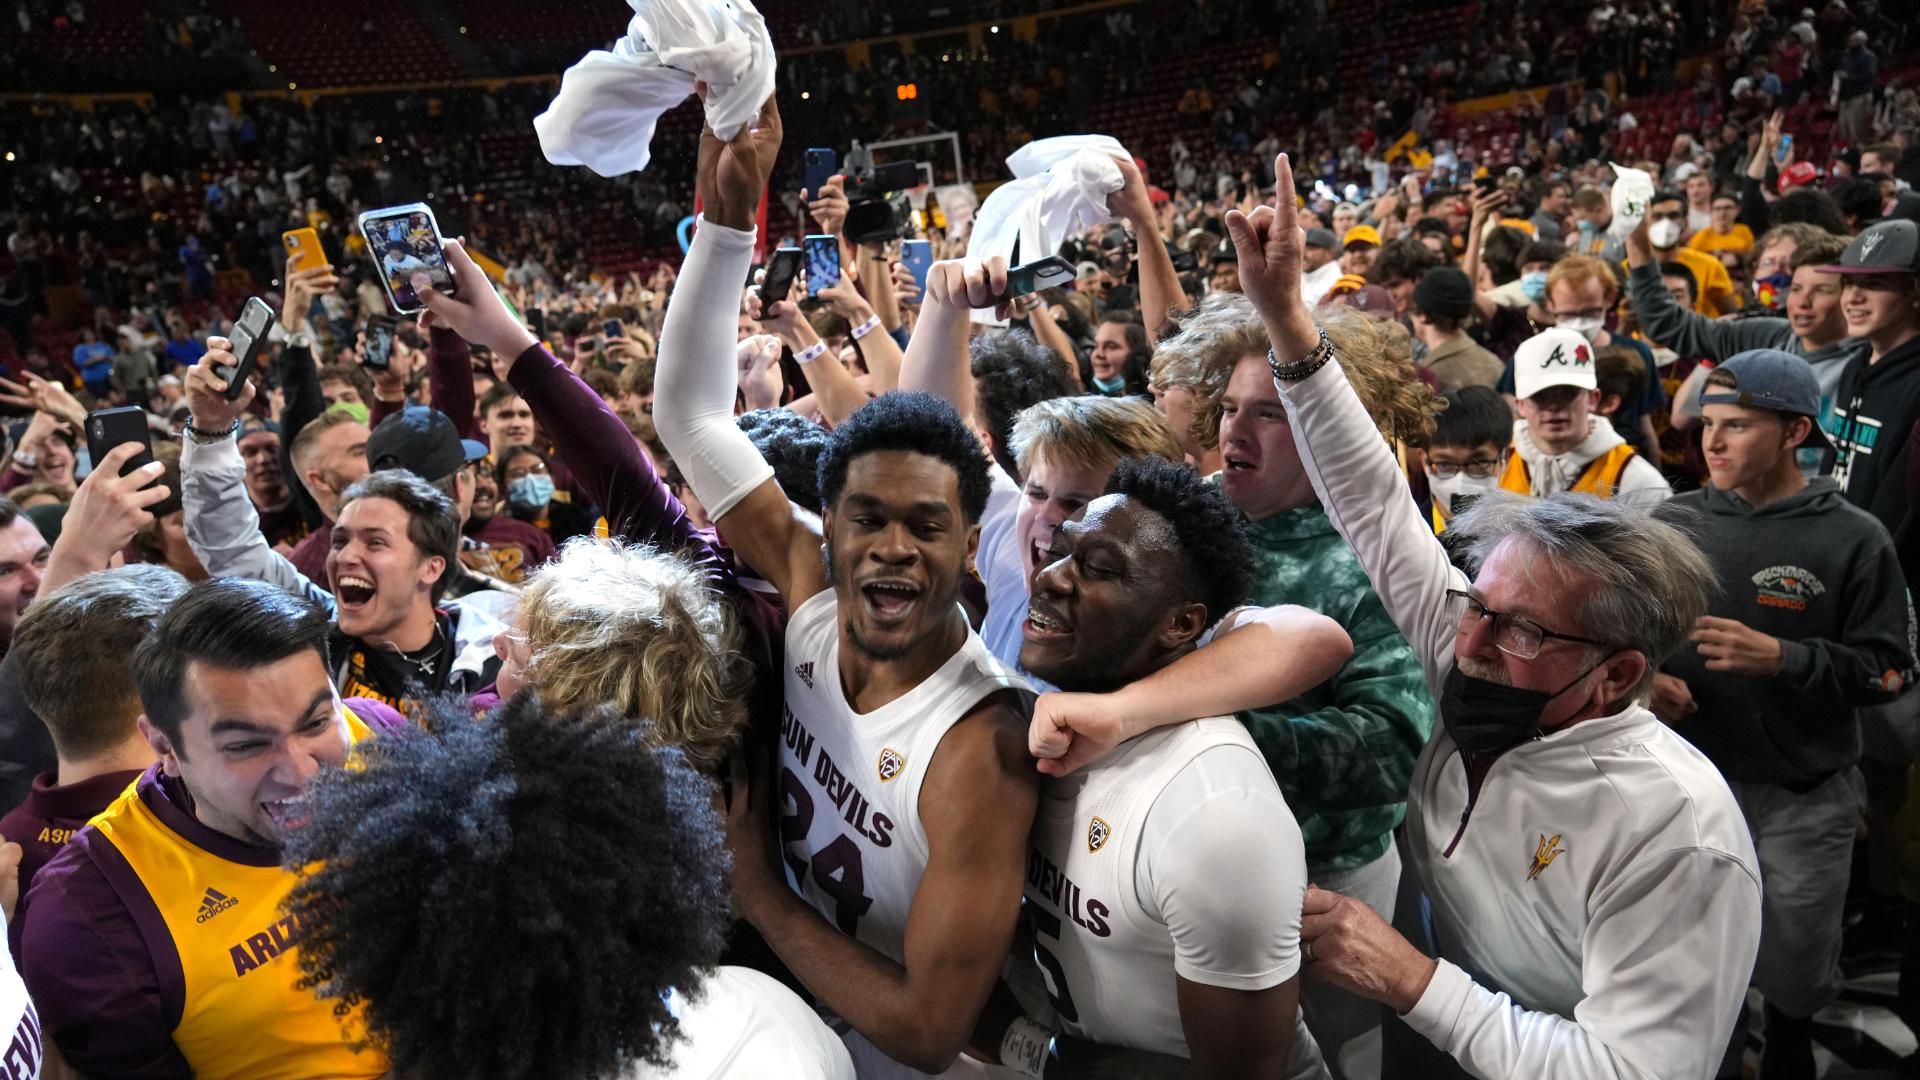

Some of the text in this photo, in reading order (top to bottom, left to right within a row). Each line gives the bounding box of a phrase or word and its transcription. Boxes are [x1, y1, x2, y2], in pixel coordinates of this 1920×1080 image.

[1540, 343, 1568, 369] A
[794, 665, 814, 690] adidas
[781, 701, 895, 848] SUN DEVILS
[880, 750, 904, 775] PAC
[880, 763, 895, 778] 12
[1090, 819, 1108, 842] PAC
[1090, 833, 1100, 849] 12
[779, 766, 874, 940] 24
[1029, 847, 1112, 938] DEVILS
[196, 896, 239, 924] adidas
[229, 905, 312, 977] ARIZ
[1029, 897, 1078, 1023] 5
